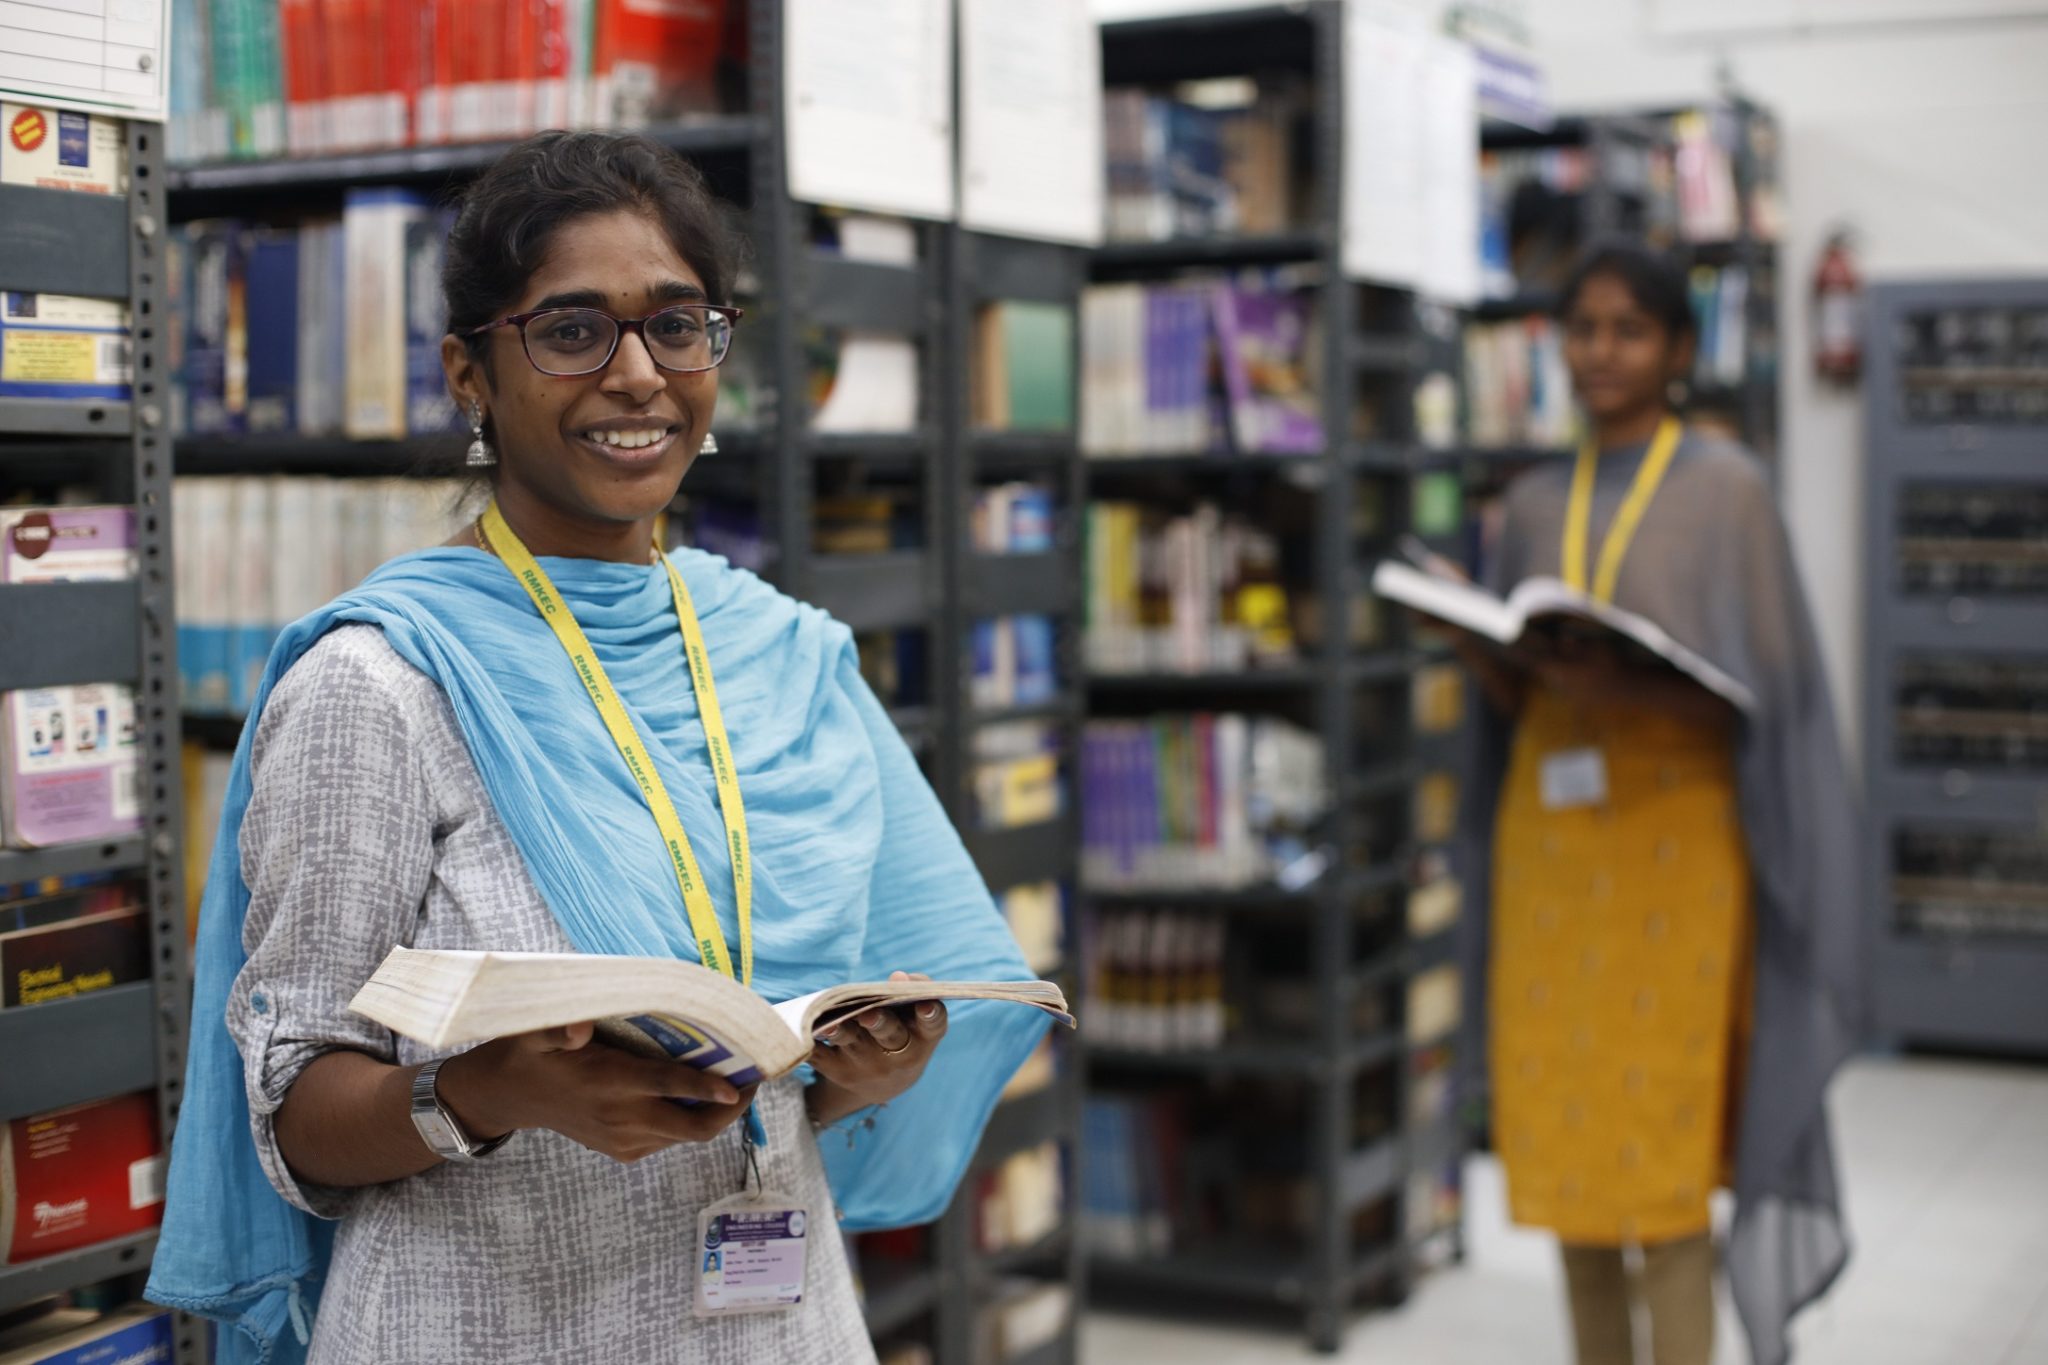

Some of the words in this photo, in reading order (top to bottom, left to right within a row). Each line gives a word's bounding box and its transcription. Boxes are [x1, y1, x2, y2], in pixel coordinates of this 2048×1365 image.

[522, 569, 556, 614] RMKEC
[574, 654, 604, 705] RMKEC
[691, 645, 708, 693] RMKEC
[624, 746, 653, 795] RMKEC
[711, 736, 728, 785] RMKEC
[669, 839, 693, 892] RMKEC
[732, 829, 744, 883] RMKEC
[701, 939, 720, 971] RMK
